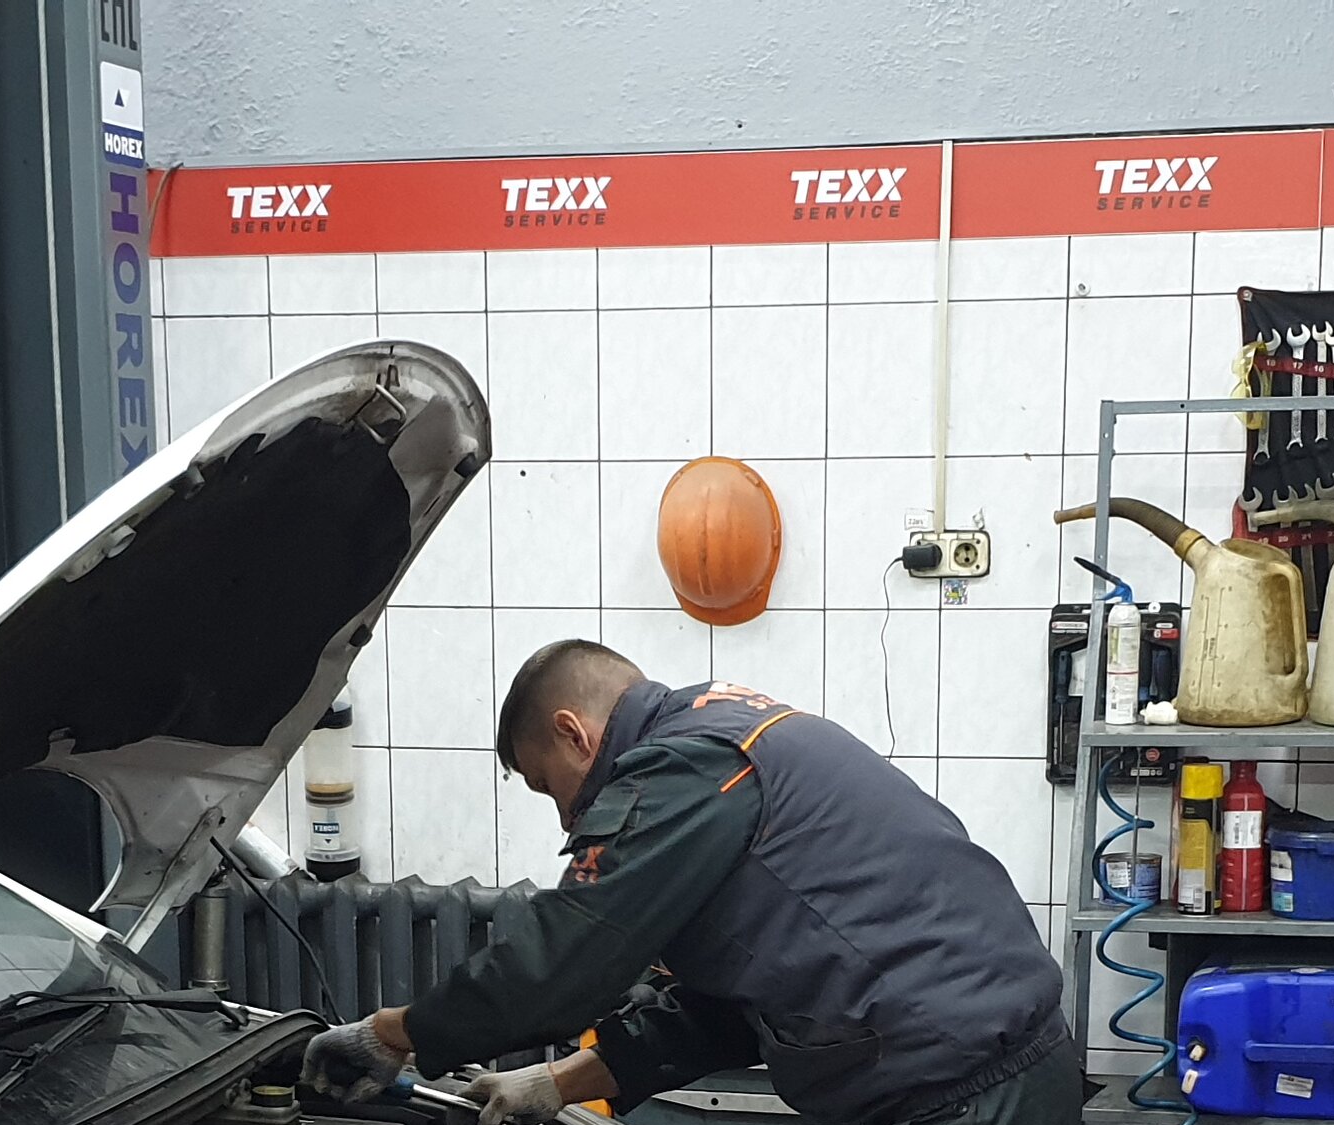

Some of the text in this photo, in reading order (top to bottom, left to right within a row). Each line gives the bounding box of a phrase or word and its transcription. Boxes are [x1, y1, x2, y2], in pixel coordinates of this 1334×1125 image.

[104, 132, 143, 159] HOREX
[791, 168, 907, 204] TEXX
[1095, 157, 1218, 194] TEXX
[227, 185, 331, 218] TEXX
[502, 177, 611, 211] TEXX
[1097, 193, 1210, 211] SERVICE
[504, 209, 607, 228] SERVICE
[793, 201, 902, 222] SERVICE
[231, 216, 329, 234] SERVICE
[1293, 361, 1303, 369] 17
[1314, 365, 1324, 373] 16
